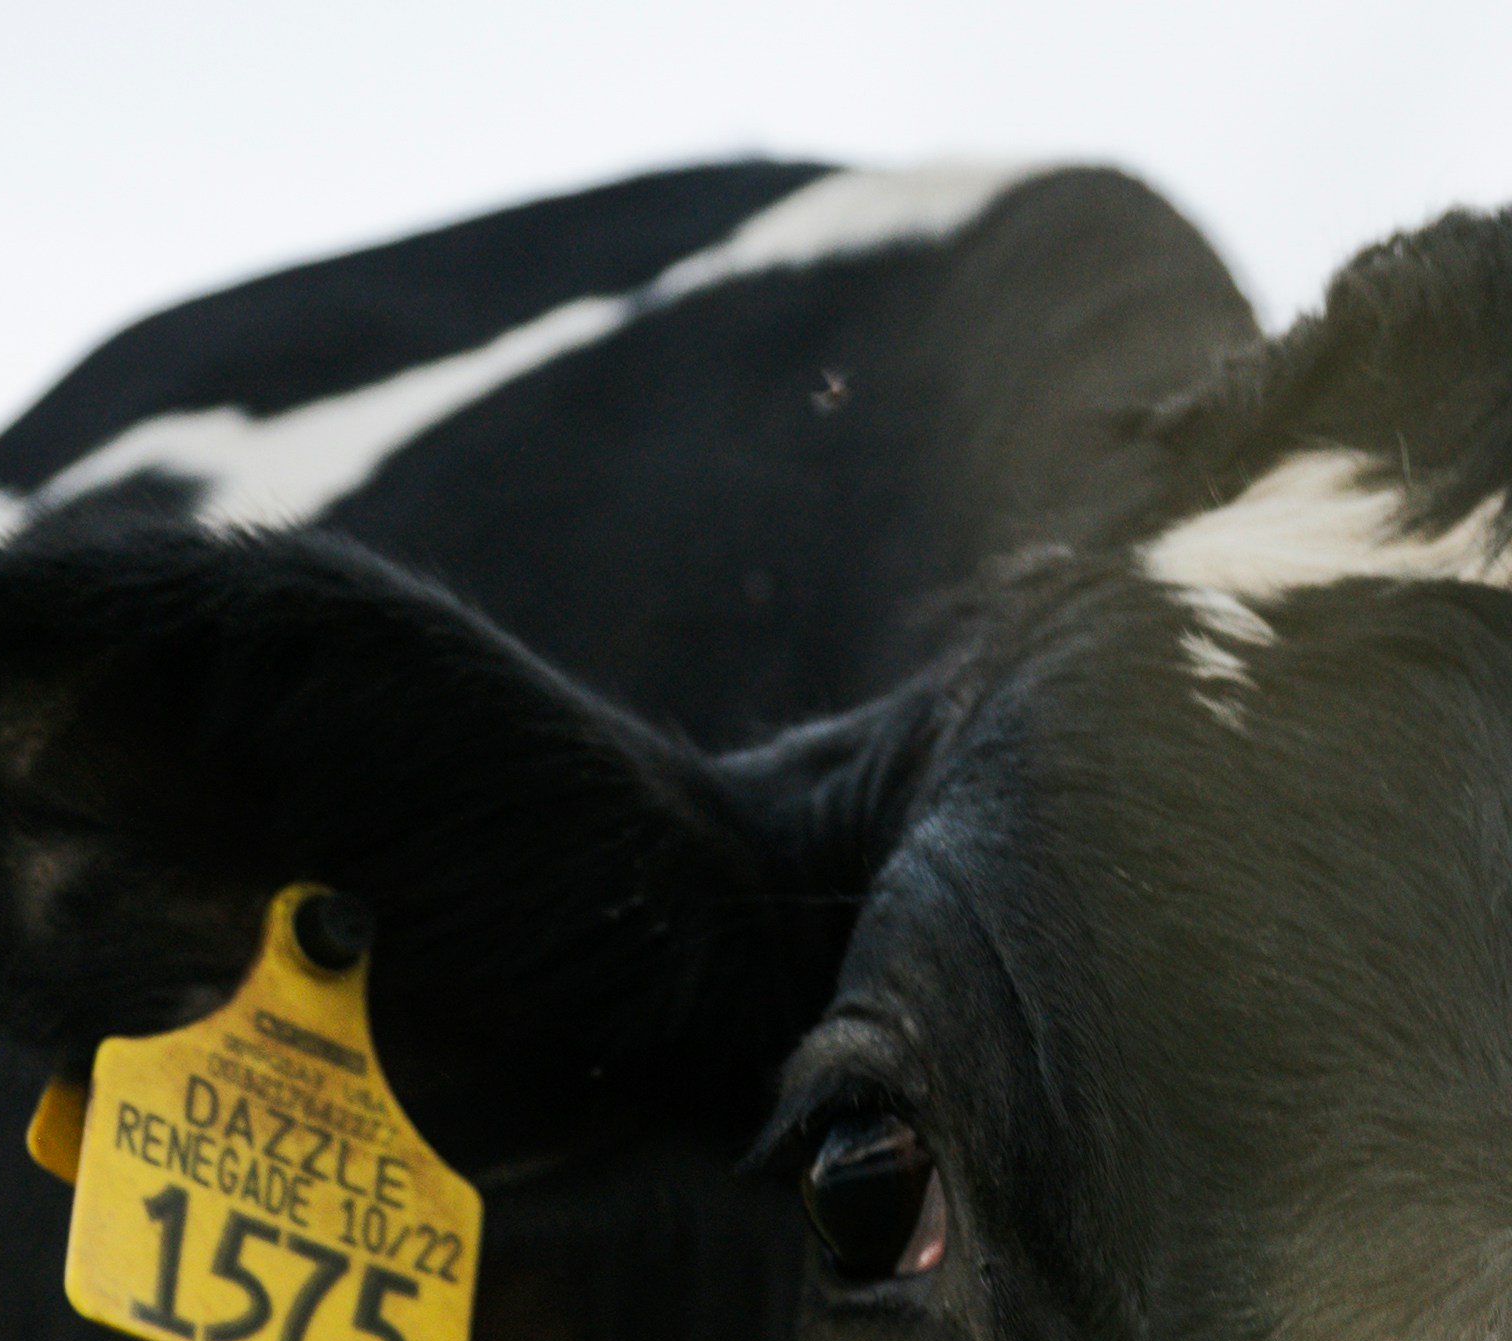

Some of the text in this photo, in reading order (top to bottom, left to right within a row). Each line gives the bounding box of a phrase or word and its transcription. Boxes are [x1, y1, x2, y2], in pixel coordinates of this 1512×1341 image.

[114, 1100, 465, 1285] RENEGADE 10/22
[183, 1073, 412, 1213] DAZZLE
